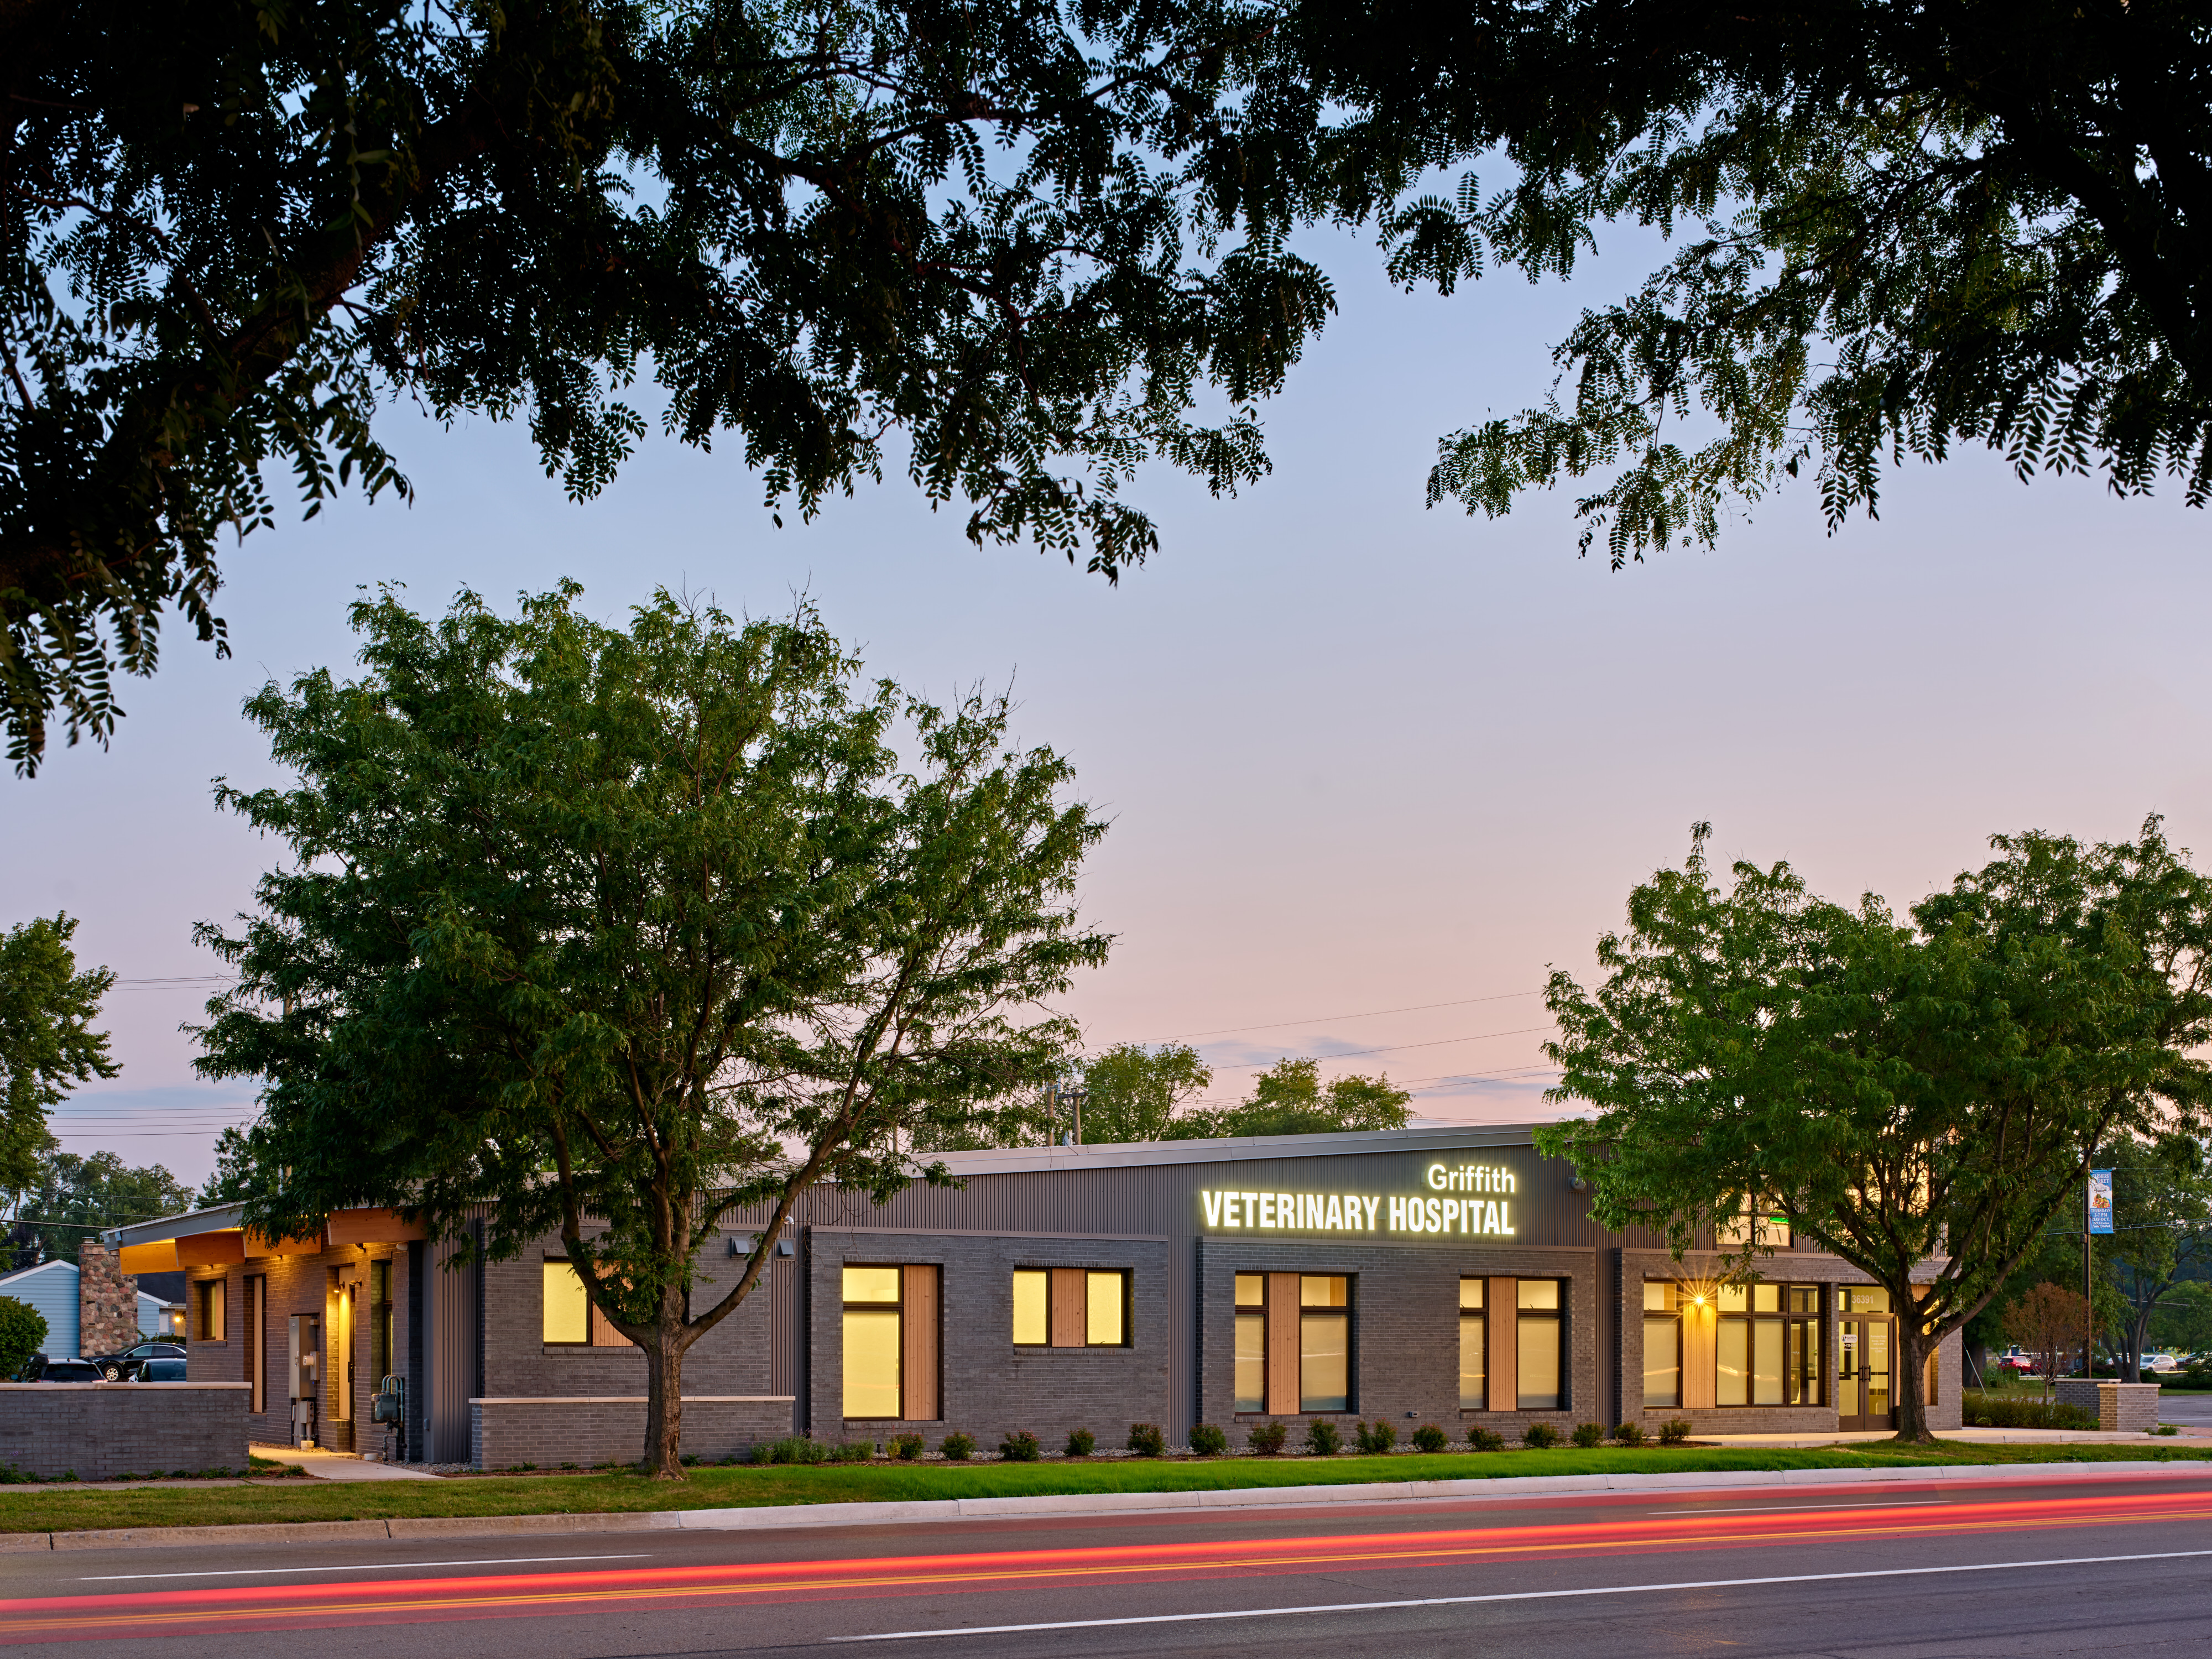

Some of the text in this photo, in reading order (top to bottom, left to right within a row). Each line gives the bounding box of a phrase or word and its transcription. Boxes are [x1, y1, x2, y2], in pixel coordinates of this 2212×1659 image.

[1428, 1164, 1515, 1193] Griffith
[1202, 1191, 1515, 1235] VETERINARY HOSPITAL
[1851, 1295, 1874, 1304] 36391
